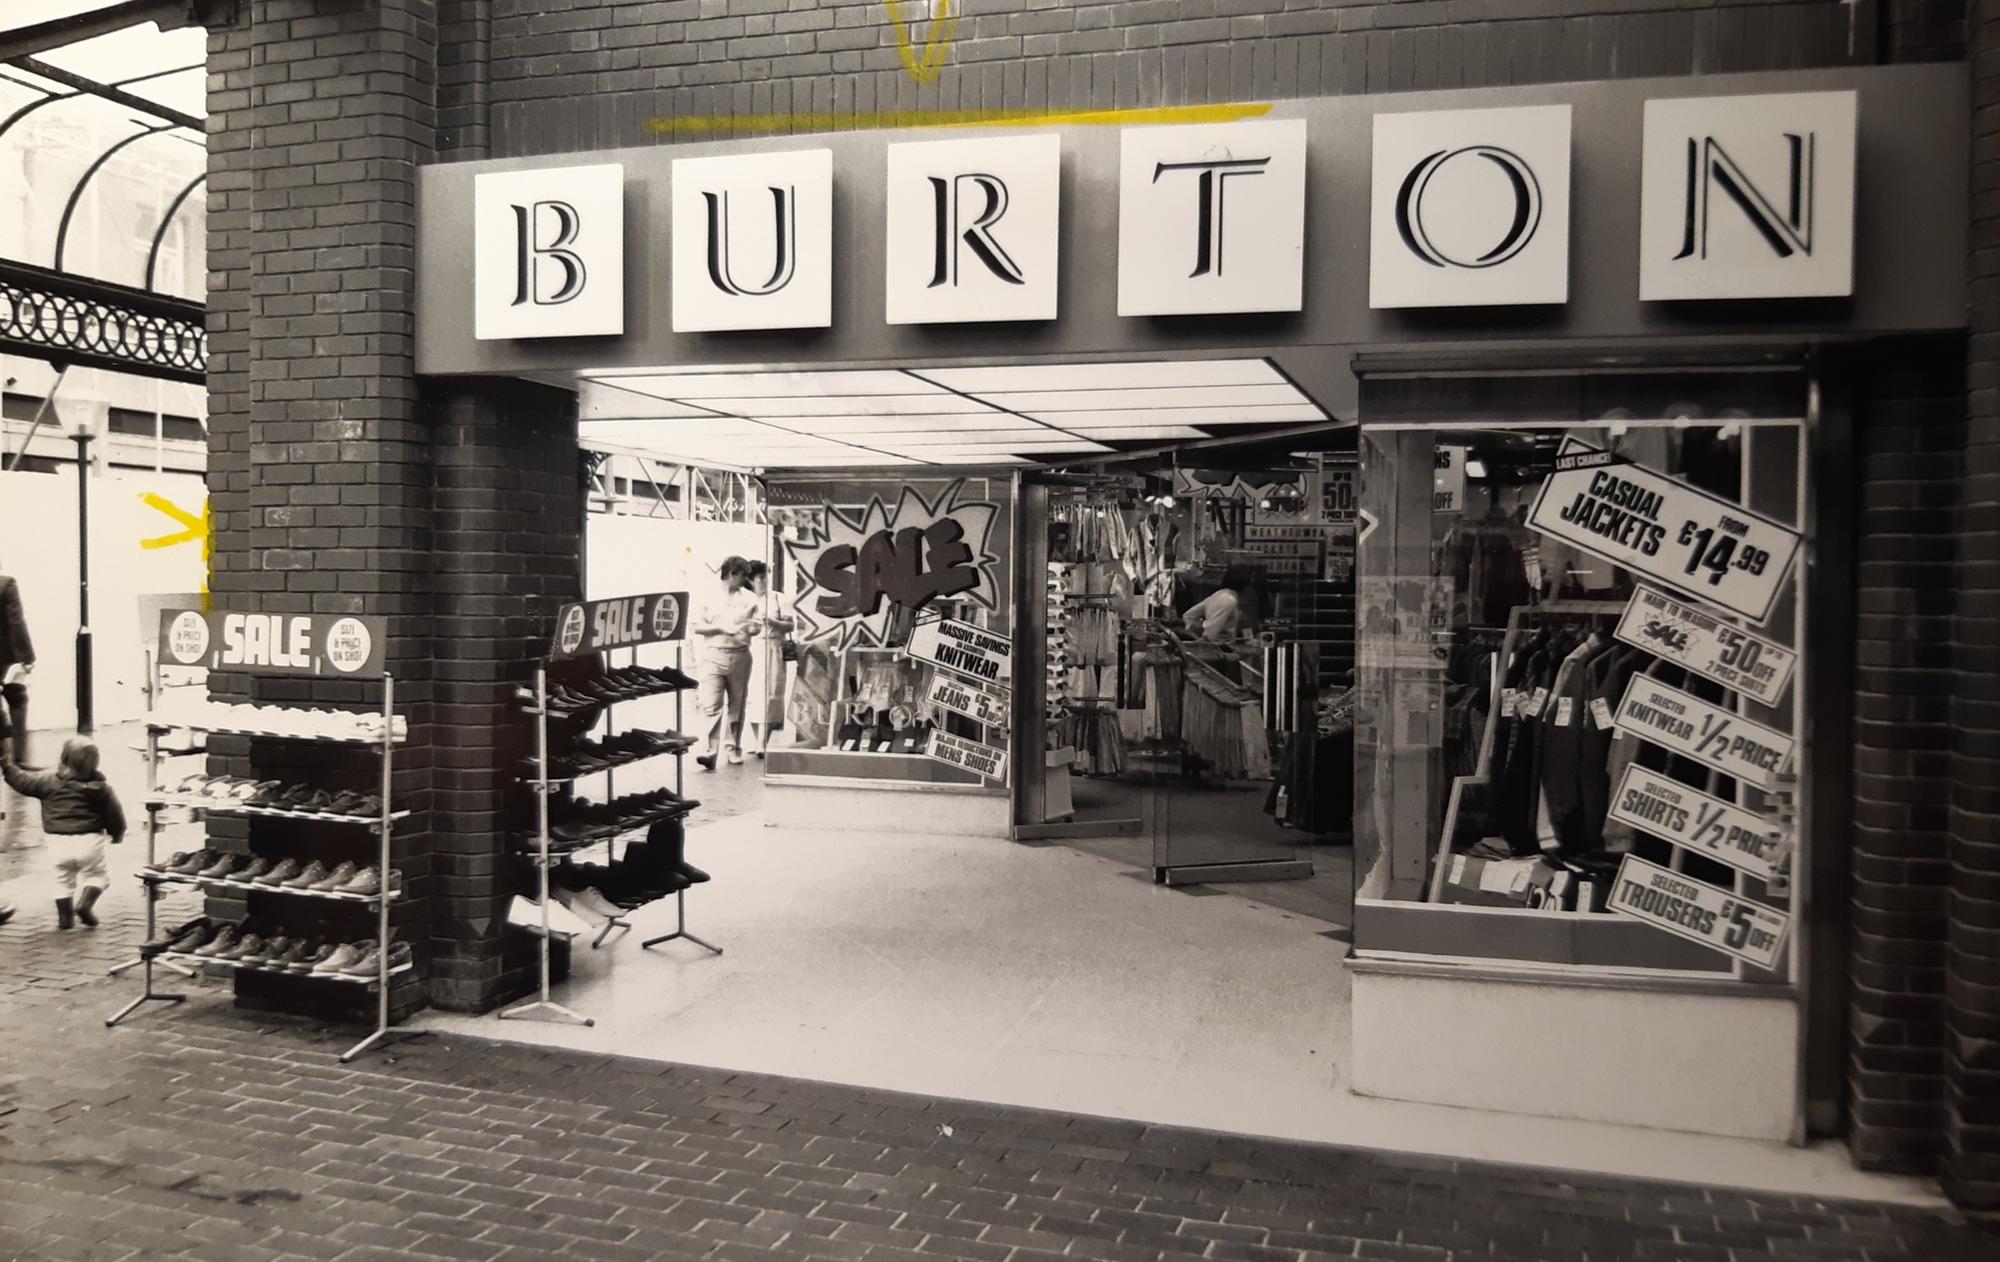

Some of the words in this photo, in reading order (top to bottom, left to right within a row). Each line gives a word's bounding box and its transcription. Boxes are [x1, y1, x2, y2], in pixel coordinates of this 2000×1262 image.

[508, 132, 1814, 305] BURTON
[1555, 456, 1576, 470] LAST
[1433, 492, 1453, 510] OFF
[1589, 470, 1664, 521] CASUAL
[1560, 493, 1666, 557] JACKETS
[1718, 515, 1750, 538] FROM
[814, 517, 980, 618] SALE
[592, 597, 646, 648] SALE
[938, 621, 974, 644] MASSIVE
[974, 635, 1010, 656] SAVINGS
[1642, 621, 1688, 651] SALE
[223, 613, 312, 667] SALE
[1717, 628, 1763, 673] £50
[935, 643, 999, 680] KNITWEAR
[1705, 660, 1715, 671] 2
[1752, 662, 1776, 682] OFF
[933, 685, 971, 711] JEANS
[975, 693, 991, 718] £5
[1649, 693, 1686, 715] SELECTED
[1626, 700, 1694, 740] KNITWEAR
[1728, 735, 1782, 772] PRICE
[934, 742, 962, 764] MENS
[964, 753, 996, 774] SHOES
[1644, 782, 1682, 804] SELECTED
[1621, 788, 1689, 832] SHIRTS
[1651, 873, 1699, 900] SELECTED
[1619, 880, 1717, 935] TROUSERS
[1720, 899, 1756, 950] £5
[1750, 928, 1776, 952] OFF
